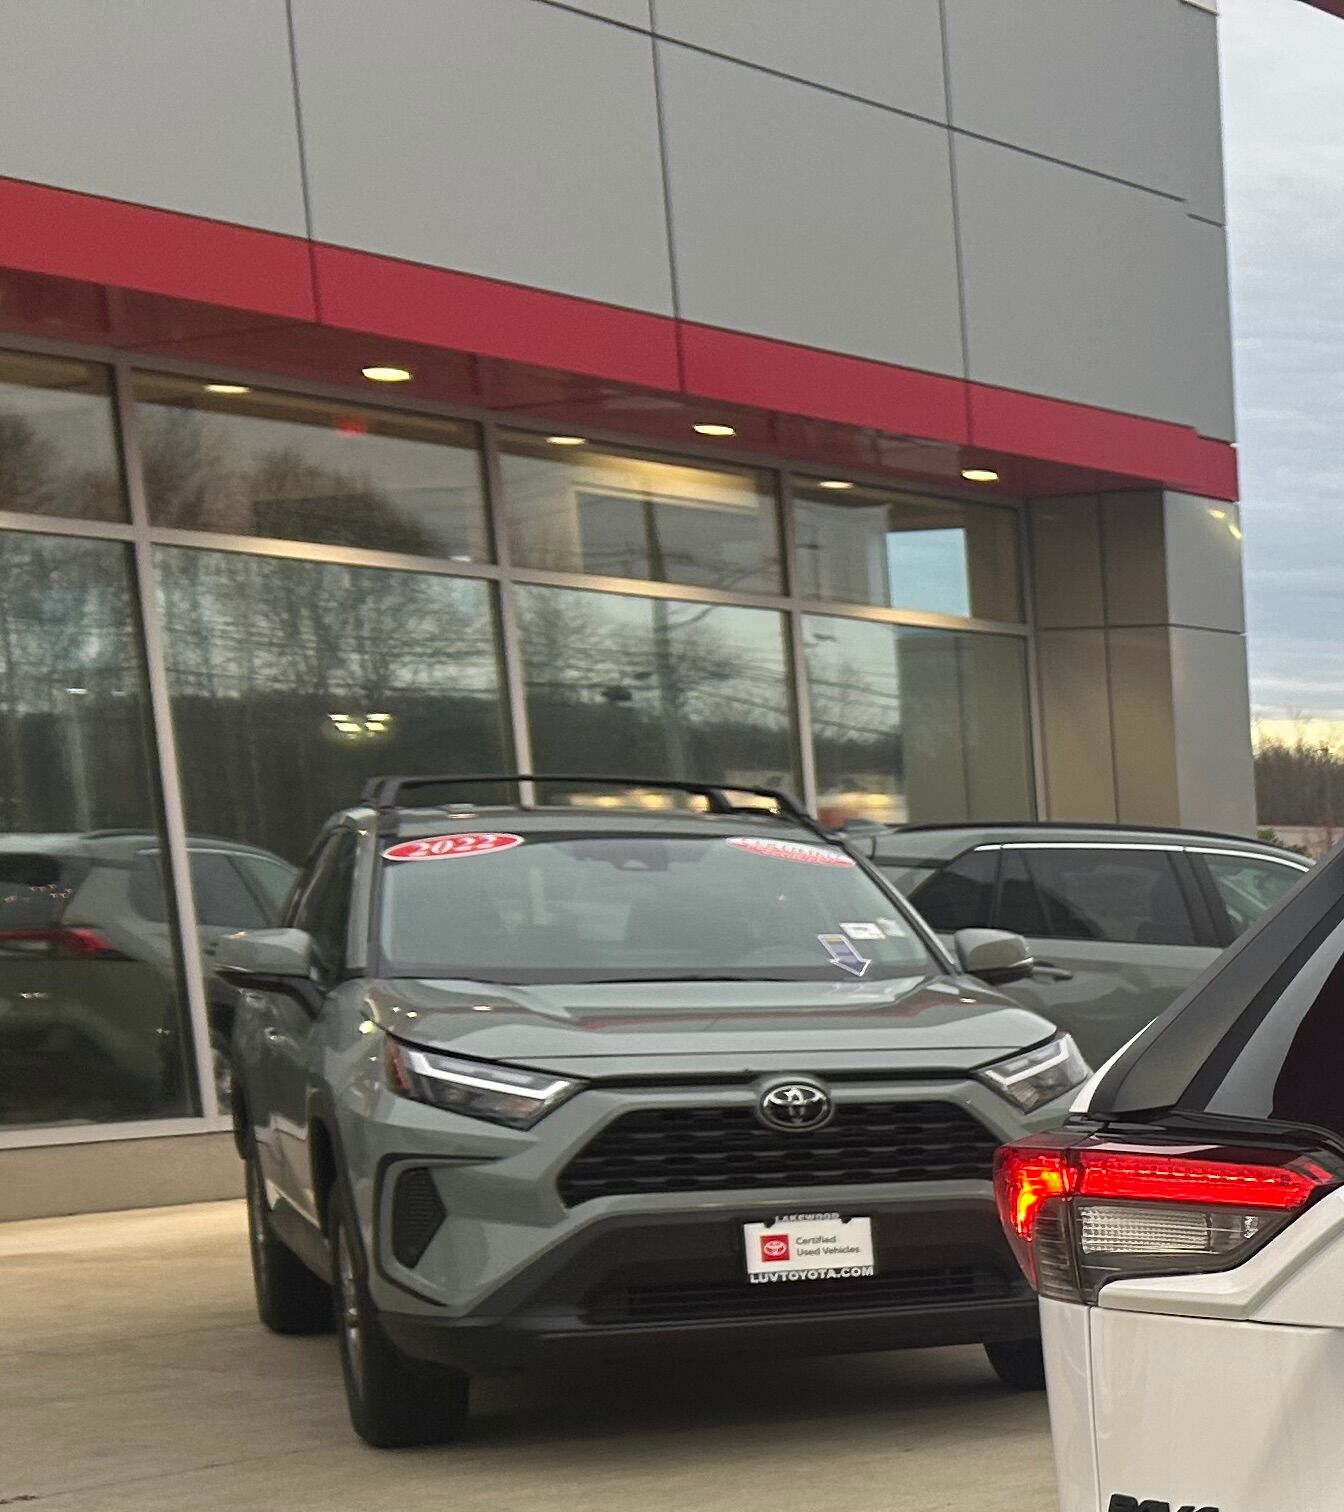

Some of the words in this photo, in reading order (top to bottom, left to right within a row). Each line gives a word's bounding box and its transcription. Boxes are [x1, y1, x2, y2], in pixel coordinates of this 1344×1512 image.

[409, 835, 497, 857] 2022
[796, 1235, 836, 1245] Certified
[797, 1248, 821, 1256] Used
[823, 1246, 860, 1255] Vehicles
[750, 1266, 873, 1284] LUVTOYOTA.COM
